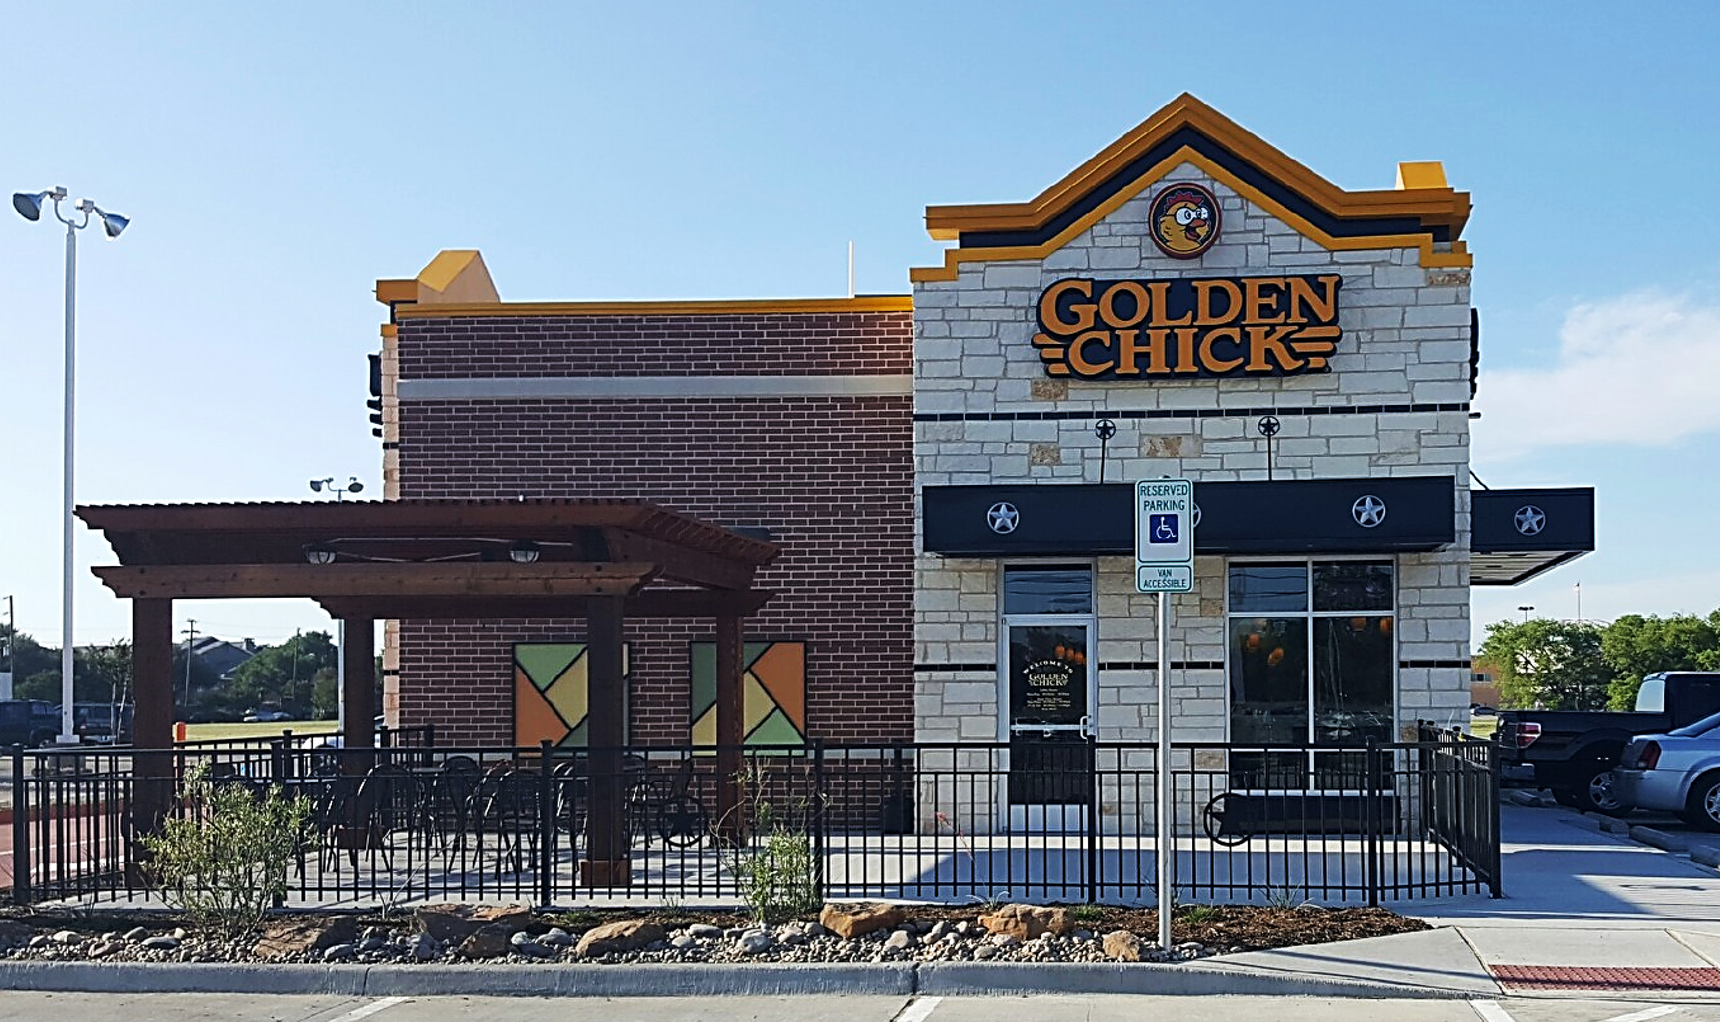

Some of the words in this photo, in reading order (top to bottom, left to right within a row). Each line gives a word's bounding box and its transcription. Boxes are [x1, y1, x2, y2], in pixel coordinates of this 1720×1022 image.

[1040, 276, 1340, 335] GOLDEN
[1068, 326, 1304, 375] CHICK
[1140, 484, 1188, 496] RESERVED
[1143, 499, 1185, 511] PARKING
[1157, 568, 1173, 577] VAN
[1143, 579, 1187, 588] ACCESSIBLE
[1023, 660, 1061, 674] WELCOME
